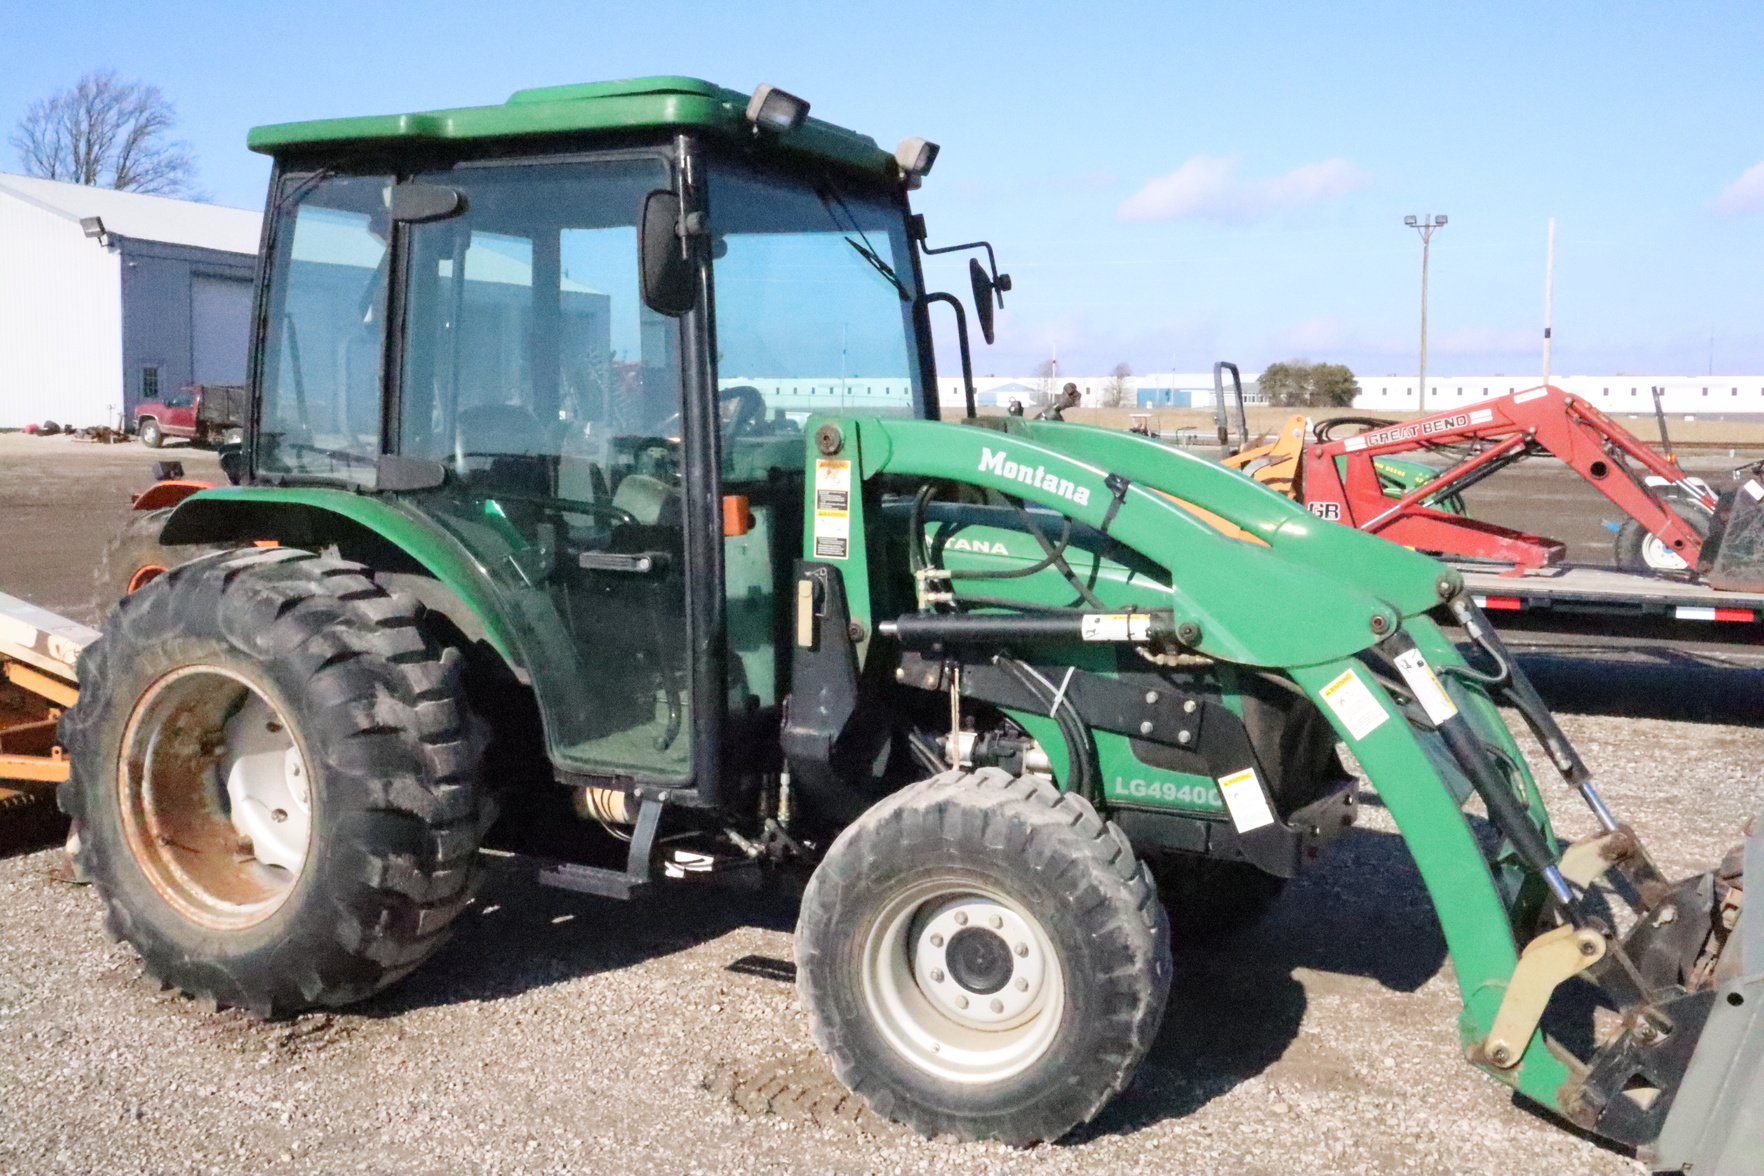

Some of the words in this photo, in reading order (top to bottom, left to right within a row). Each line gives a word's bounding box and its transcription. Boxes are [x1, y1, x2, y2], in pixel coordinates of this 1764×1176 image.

[1368, 425, 1418, 446] GREAT
[1422, 415, 1467, 434] BEND
[978, 447, 1090, 506] Montana
